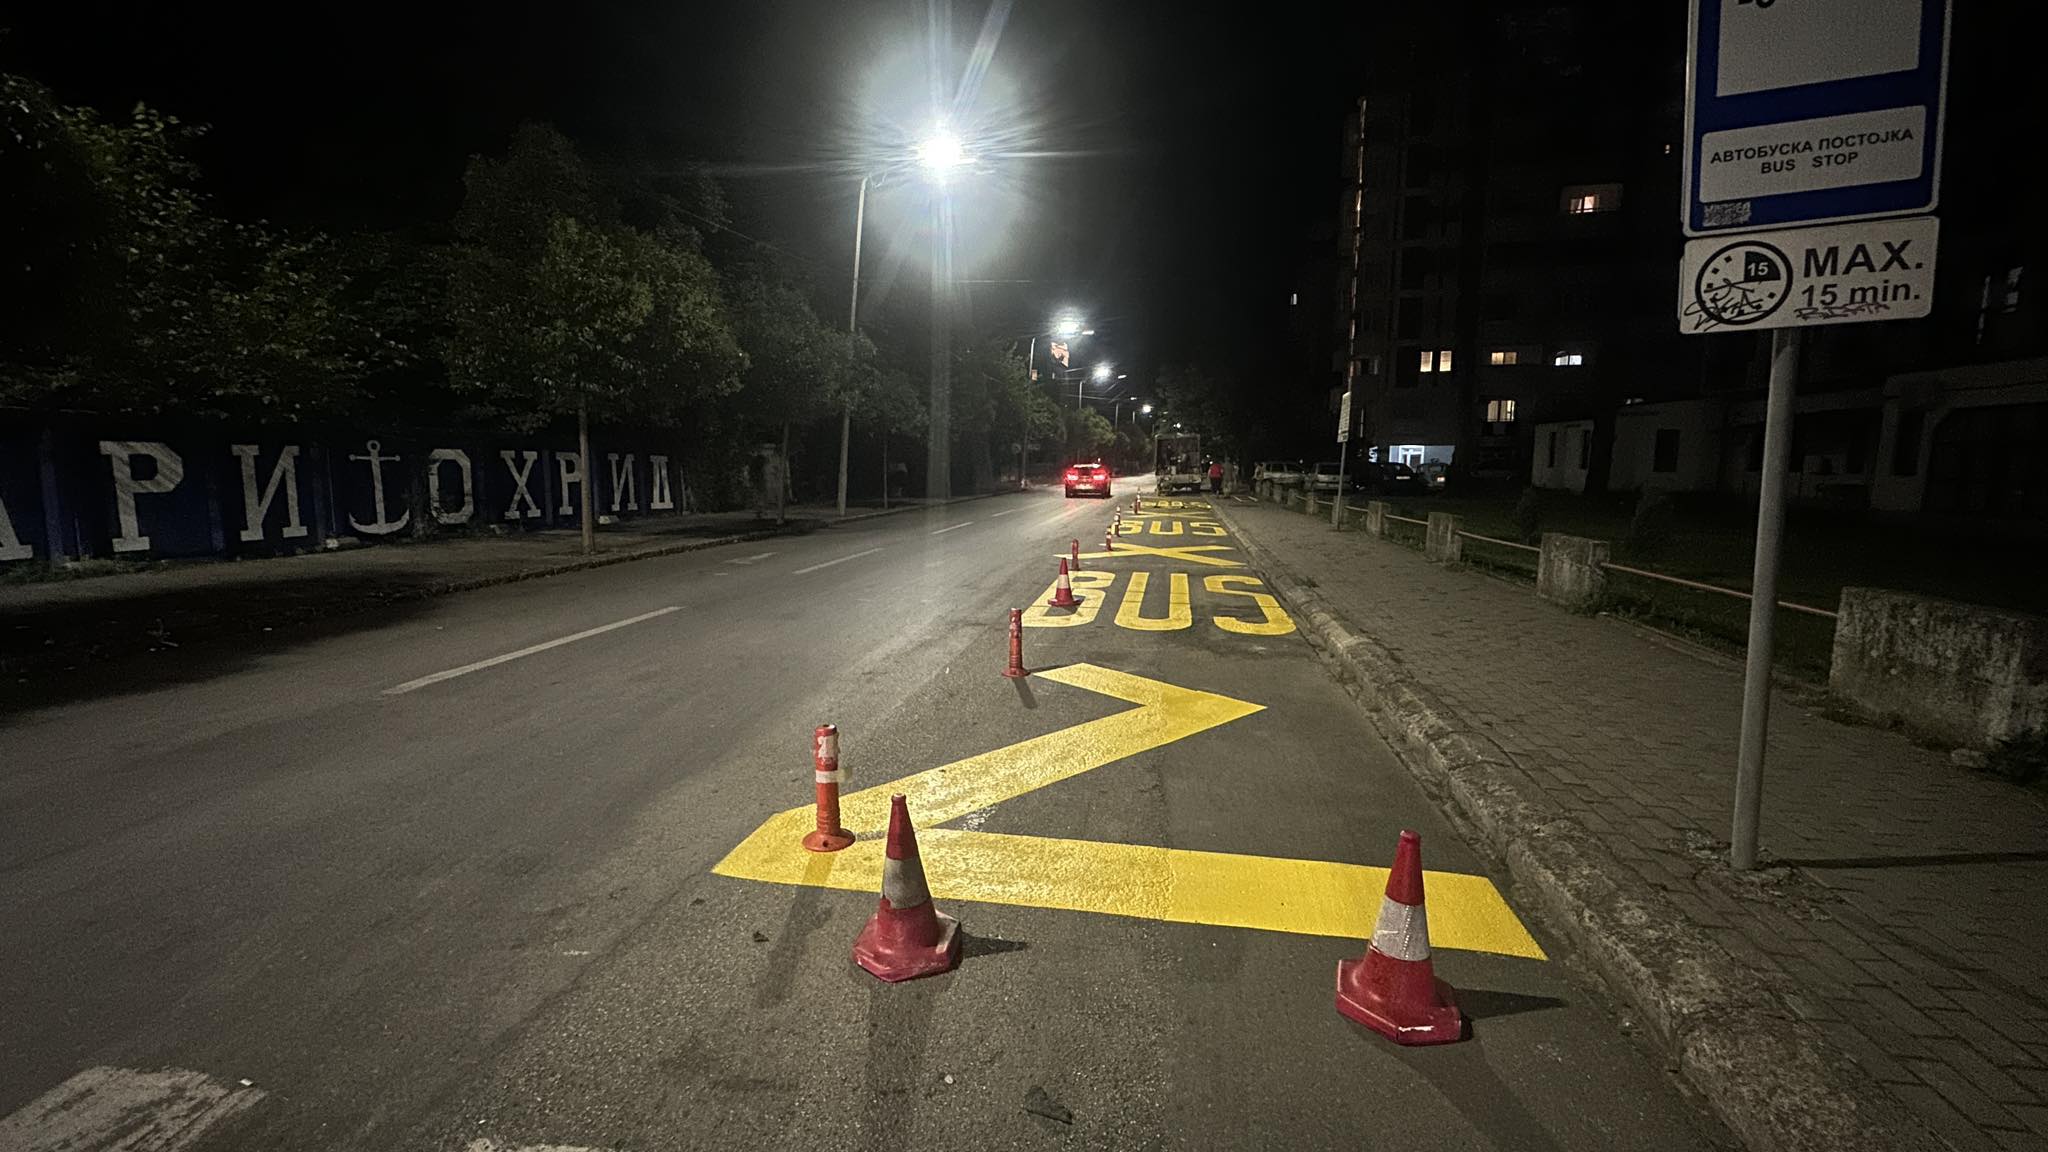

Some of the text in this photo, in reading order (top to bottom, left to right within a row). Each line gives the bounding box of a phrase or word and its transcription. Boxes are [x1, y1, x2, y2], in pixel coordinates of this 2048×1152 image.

[1711, 129, 1913, 164] АВТОБУСКА ПОСТОЈКА
[1761, 152, 1858, 174] BUS STOP
[1747, 261, 1769, 277] 15
[1803, 240, 1924, 278] MAX.
[1801, 279, 1921, 307] 15 min.
[1111, 520, 1228, 537] BUS
[1022, 570, 1297, 636] BUS
